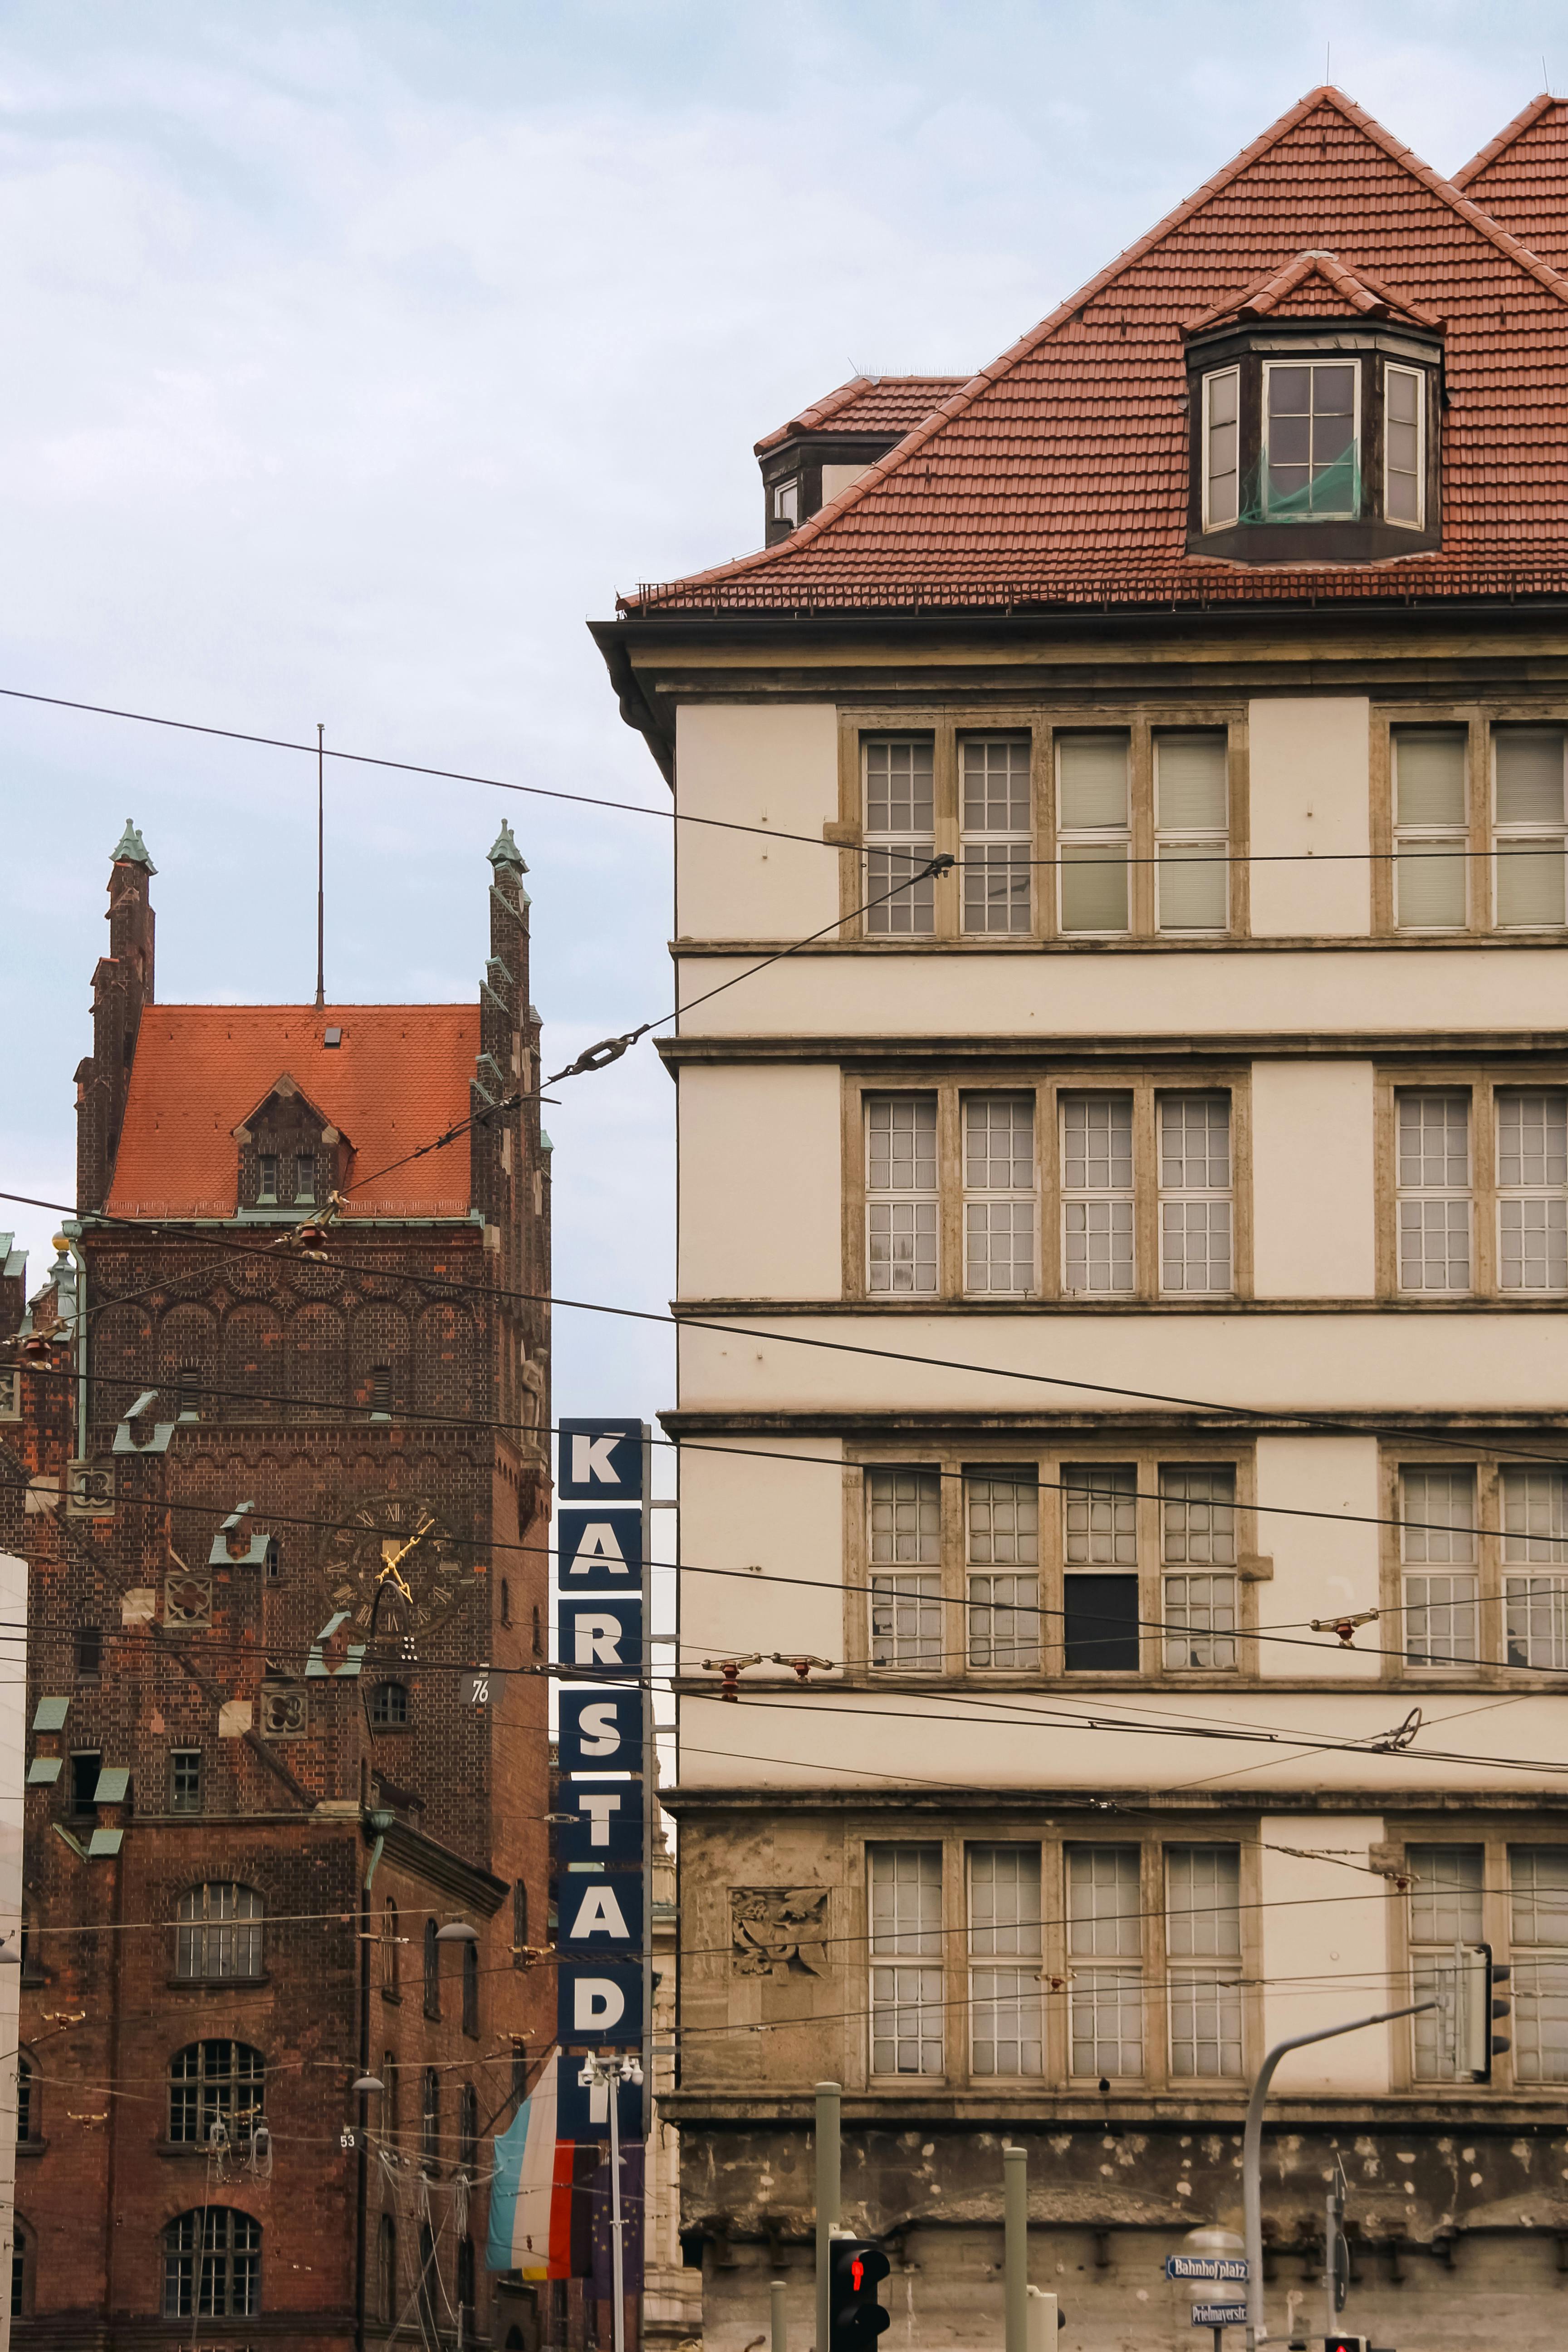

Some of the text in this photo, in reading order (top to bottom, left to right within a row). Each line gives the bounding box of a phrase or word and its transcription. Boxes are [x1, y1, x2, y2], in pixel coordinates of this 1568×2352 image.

[472, 1680, 489, 1702] 76
[569, 1432, 630, 2123] KARSTADT
[340, 2134, 355, 2148] 53
[1175, 2258, 1245, 2280] Bahnhofplatz
